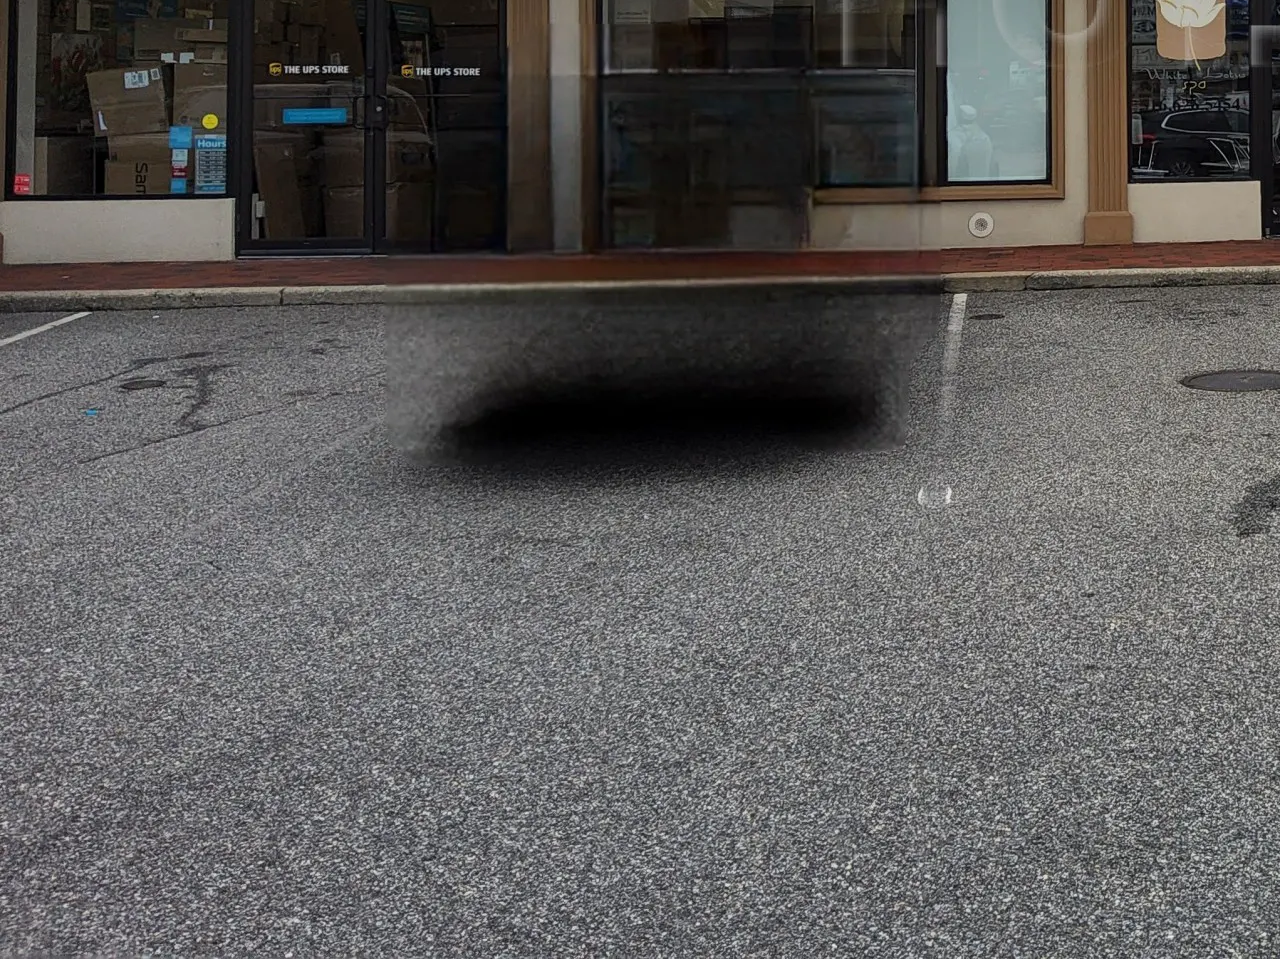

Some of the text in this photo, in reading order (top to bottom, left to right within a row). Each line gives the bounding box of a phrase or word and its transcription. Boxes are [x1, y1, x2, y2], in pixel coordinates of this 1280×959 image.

[284, 65, 349, 74] THE UPS STORE
[416, 67, 481, 76] THE UPS STORE
[1141, 67, 1188, 80] White
[197, 139, 226, 148] Hours
